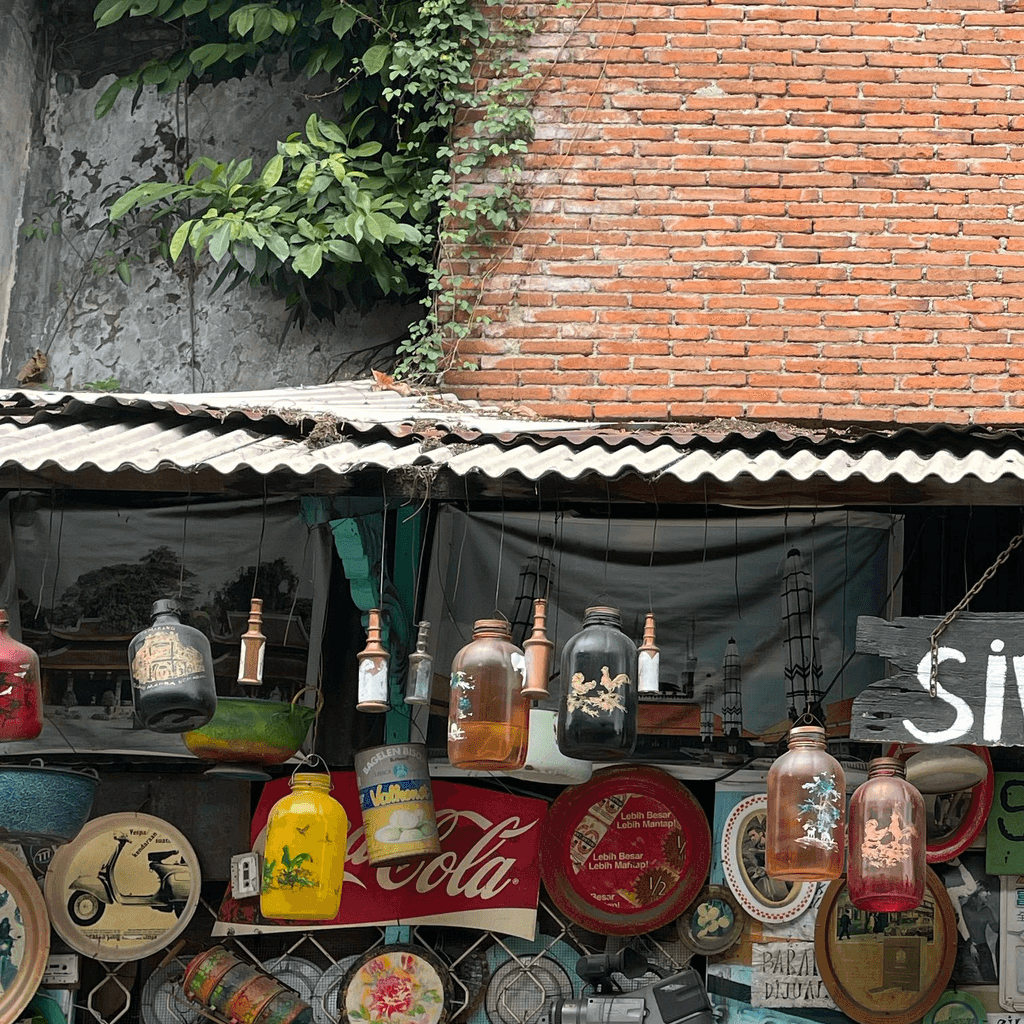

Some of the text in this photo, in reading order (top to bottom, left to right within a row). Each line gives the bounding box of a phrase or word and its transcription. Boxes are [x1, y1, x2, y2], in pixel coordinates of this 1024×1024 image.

[362, 747, 401, 775] BAGELEN
[621, 811, 671, 820] Lebih Besar
[616, 819, 676, 829] Lebih Mantap!
[131, 831, 158, 858] kendaraan
[592, 852, 643, 861] Lebih Besar
[588, 862, 612, 870] Lebih
